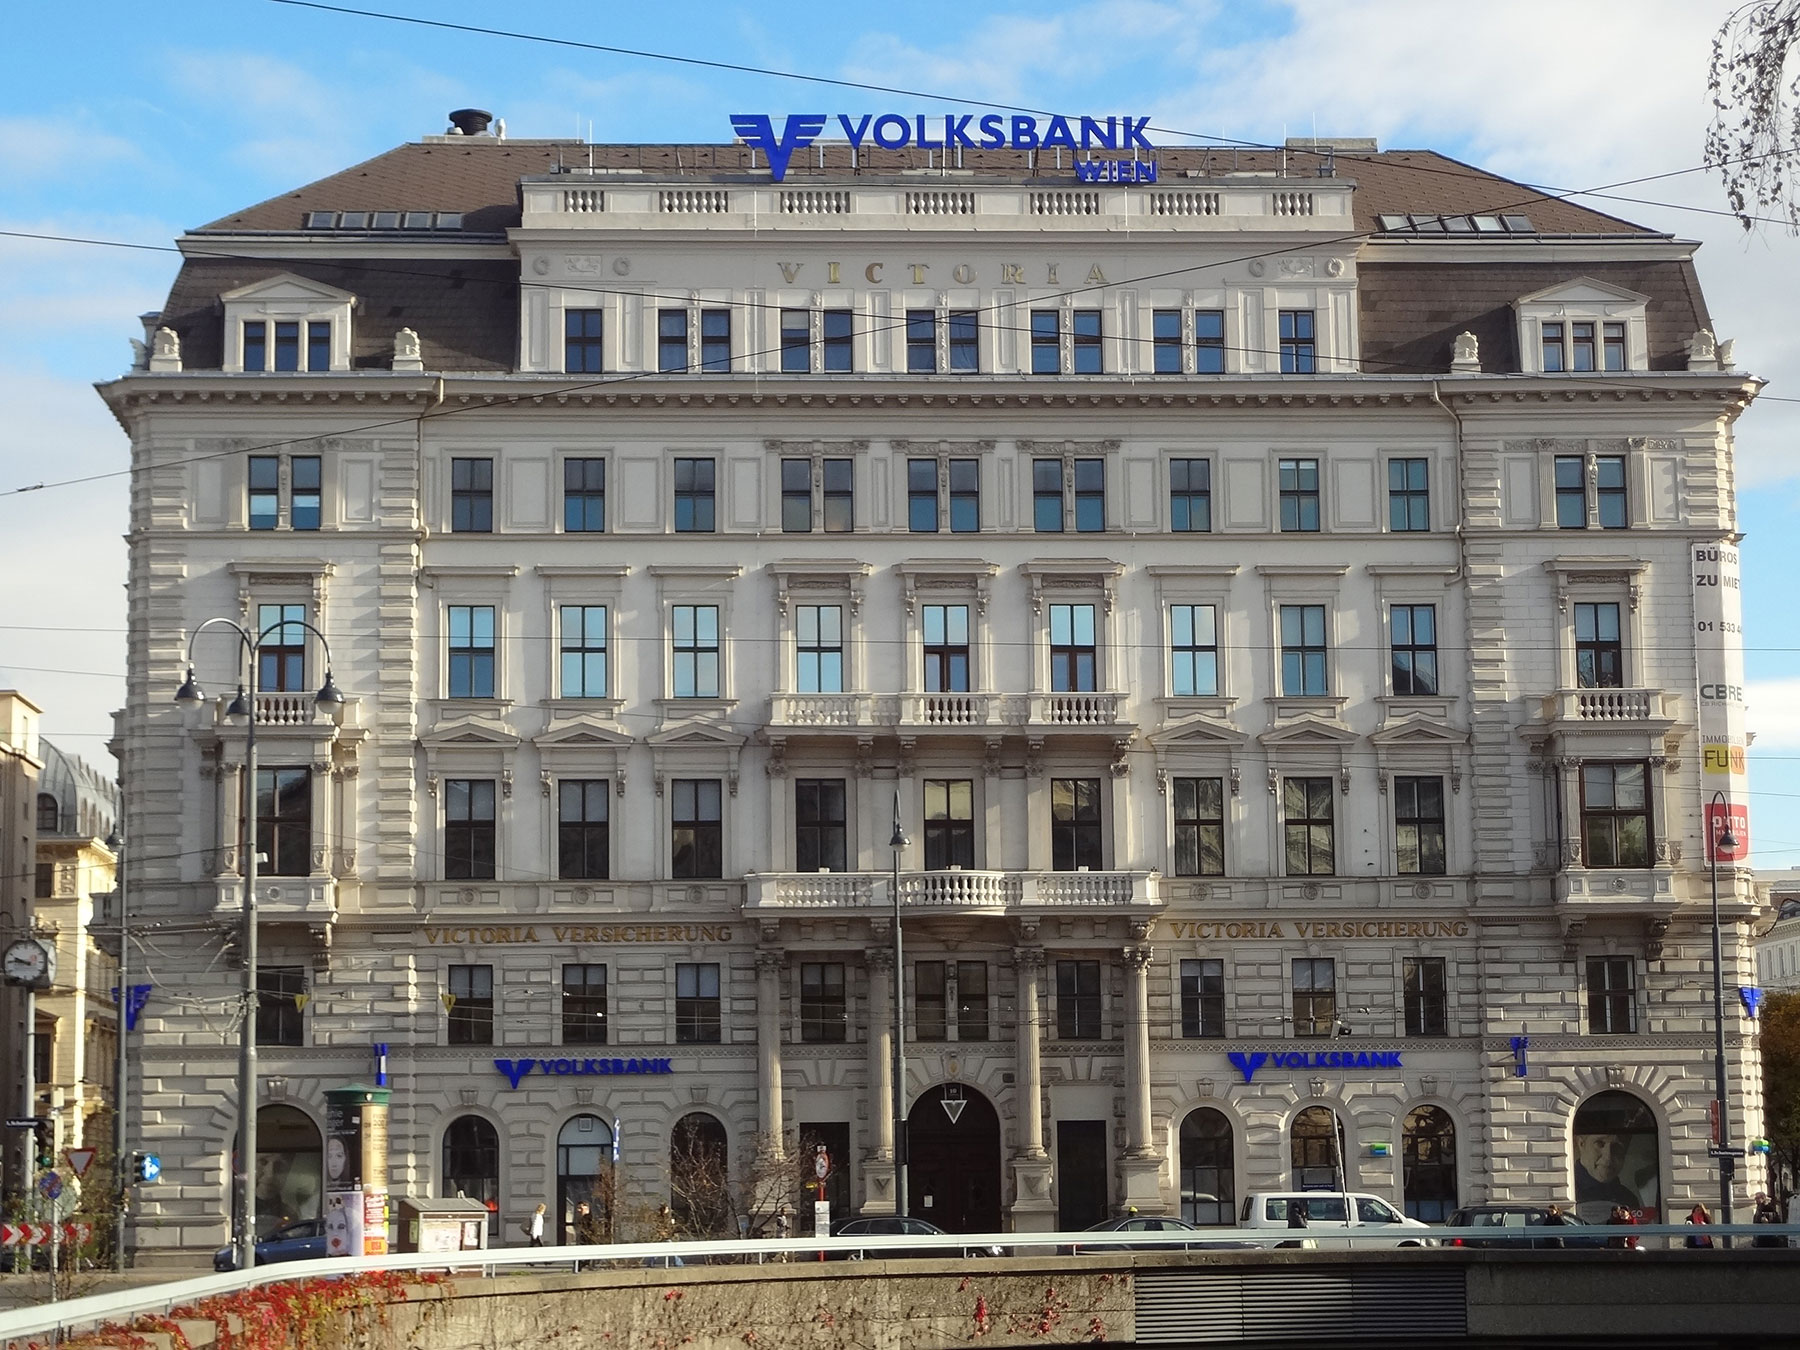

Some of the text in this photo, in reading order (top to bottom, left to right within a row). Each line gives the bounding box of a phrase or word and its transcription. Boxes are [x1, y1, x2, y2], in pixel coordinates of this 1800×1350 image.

[838, 113, 1156, 150] VOLKSBANK
[1073, 160, 1157, 182] WIEN
[776, 261, 1110, 285] VICTORIA
[1695, 546, 1738, 566] BÜROS
[1696, 574, 1719, 587] ZU
[1697, 621, 1713, 632] 01
[1719, 621, 1736, 634] 533
[1700, 683, 1743, 702] CBRE
[1704, 749, 1745, 770] FUNK
[424, 925, 733, 945] VICTORIA VERSICHERUNG
[1169, 920, 1470, 939] VICTORIA VERSICHERUNG
[540, 1058, 674, 1075] VOLKSBANK
[1271, 1051, 1404, 1069] VOLKSBANK
